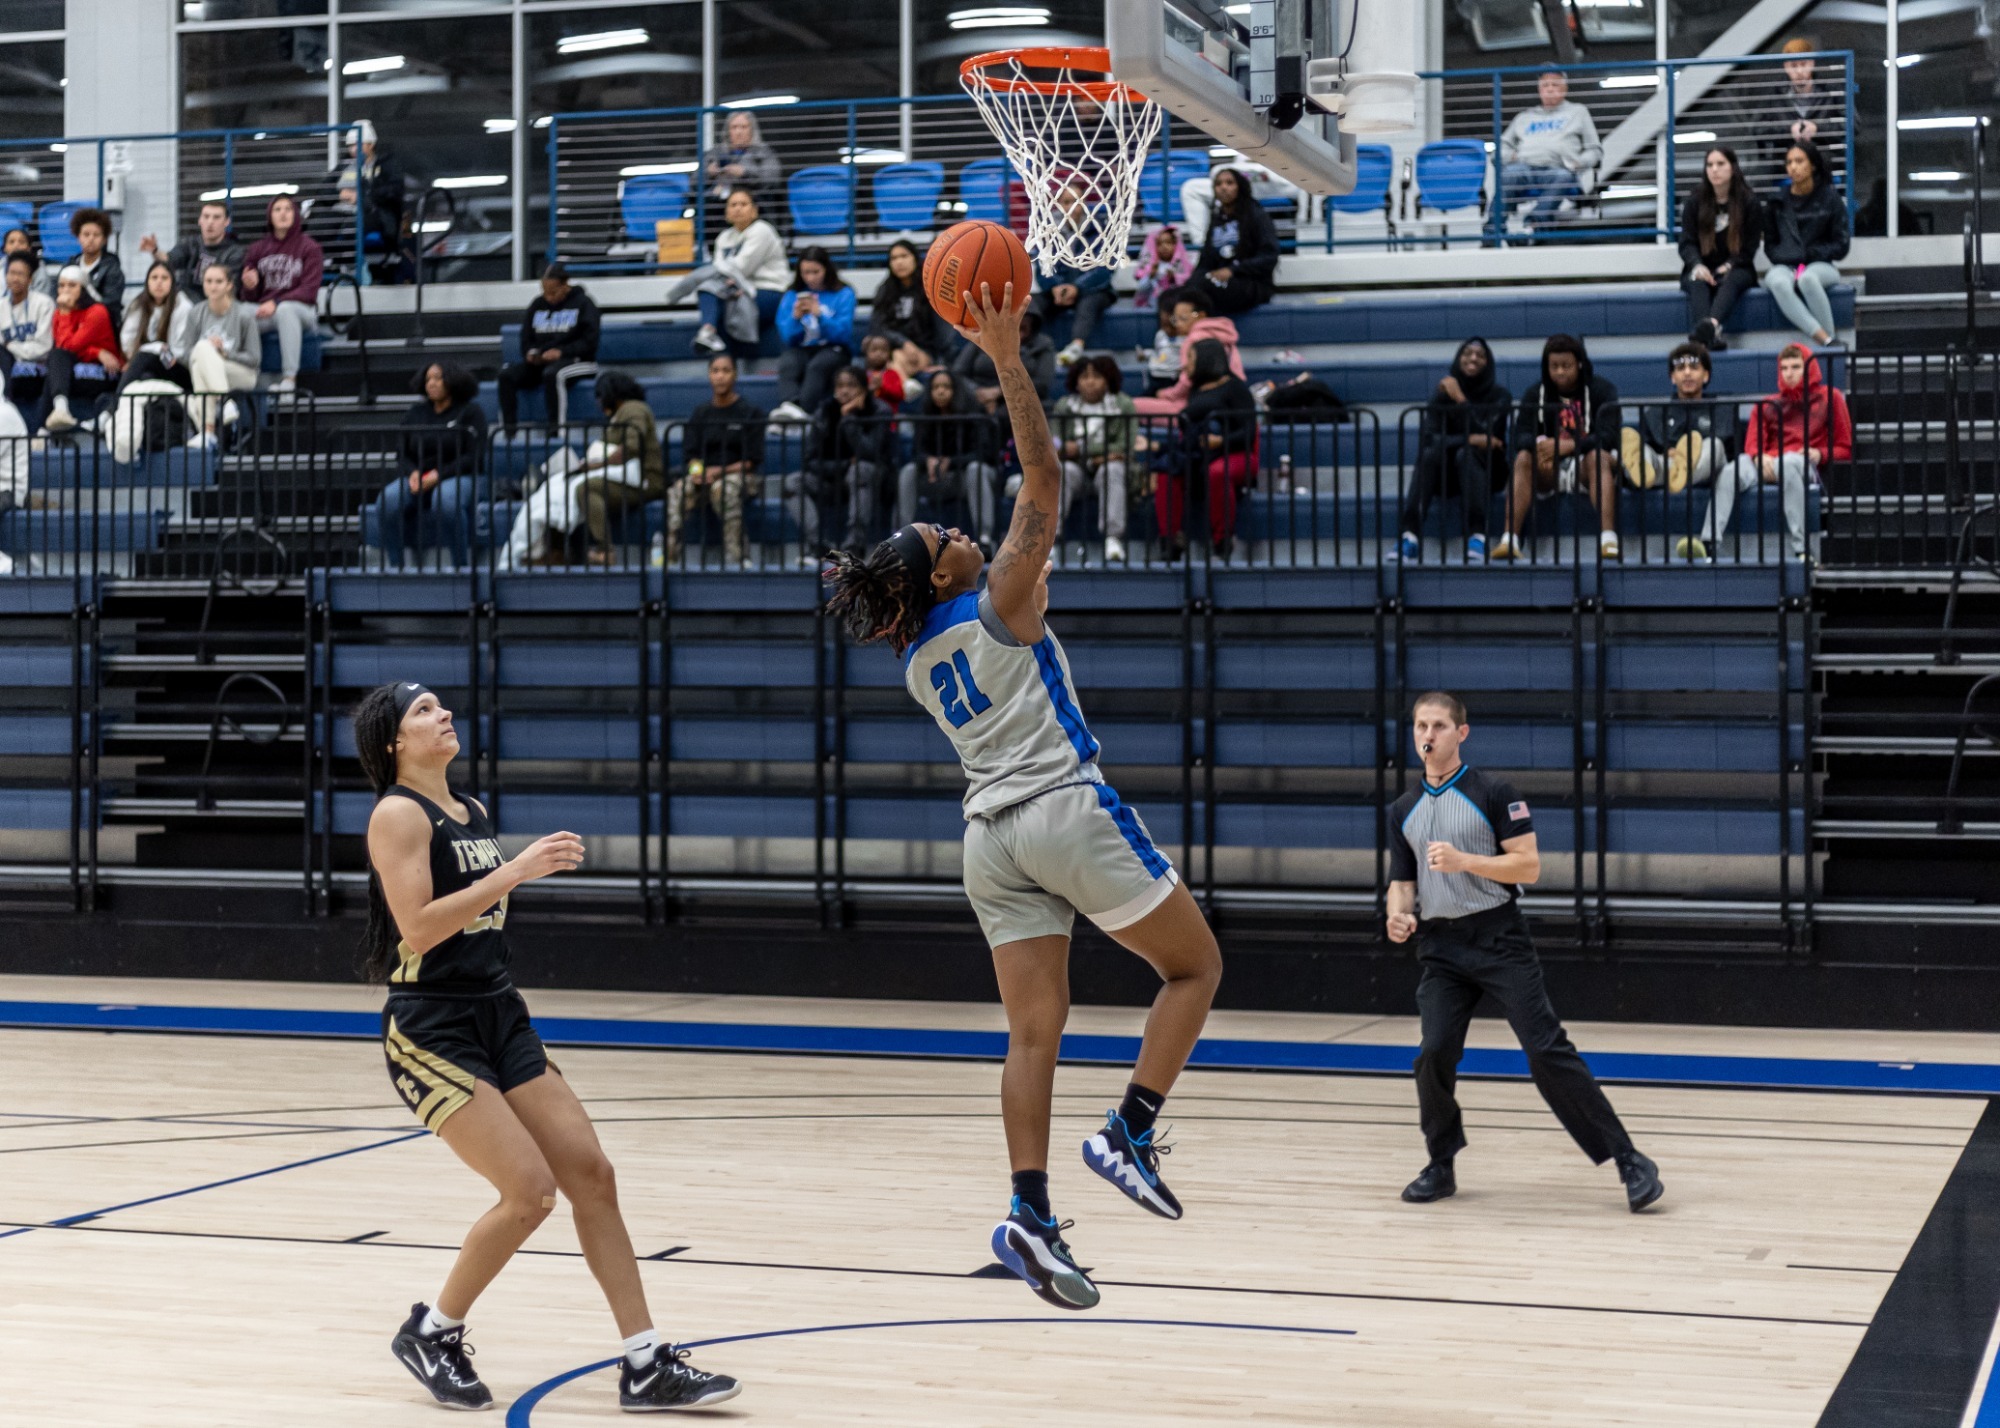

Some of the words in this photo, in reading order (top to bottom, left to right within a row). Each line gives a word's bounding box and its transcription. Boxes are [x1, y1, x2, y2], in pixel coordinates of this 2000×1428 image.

[1252, 25, 1274, 35] 9'6"
[1260, 94, 1274, 104] 10'
[930, 648, 993, 729] 21
[451, 838, 507, 873] TEMPL
